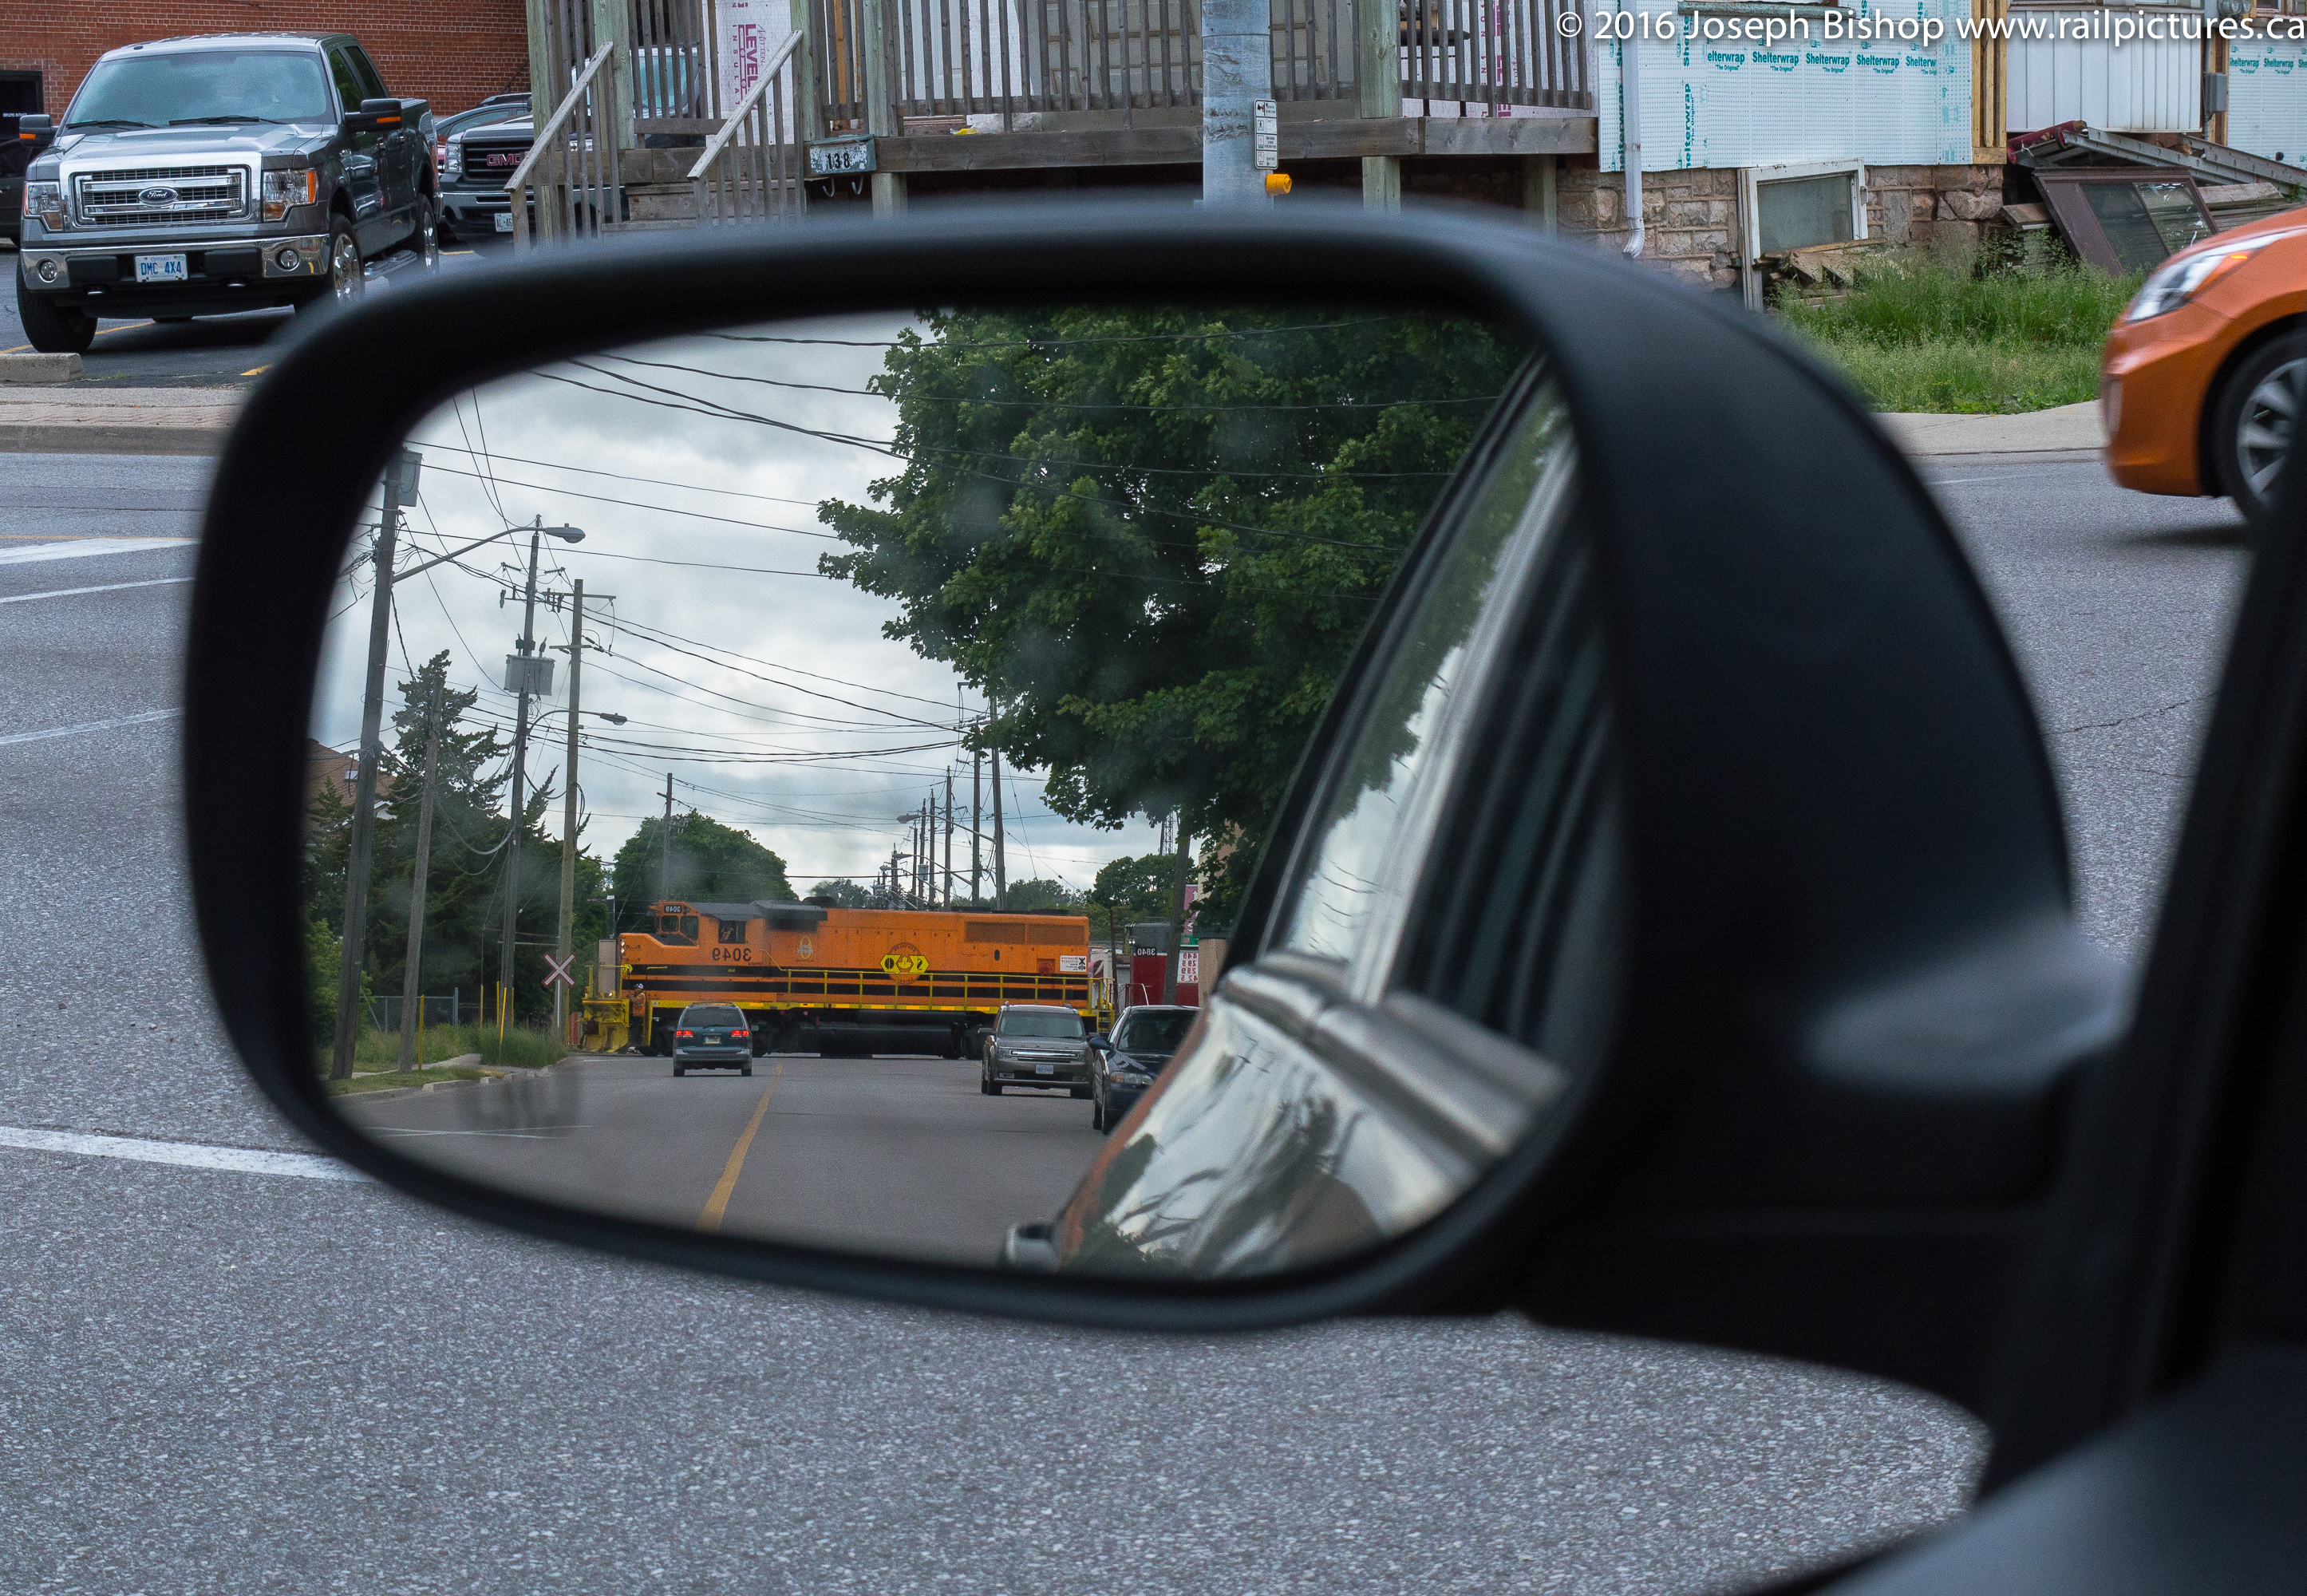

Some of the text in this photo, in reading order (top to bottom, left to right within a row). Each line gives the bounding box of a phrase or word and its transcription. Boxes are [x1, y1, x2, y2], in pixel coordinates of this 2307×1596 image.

[1752, 51, 1799, 66] Shelterwrap
[1806, 53, 1850, 67] Shelterwrap
[1857, 54, 1900, 68] Shelterwrap
[2264, 57, 2294, 70] Shelterwrap
[487, 153, 522, 166] GMC
[828, 152, 850, 169] 138
[147, 190, 167, 200] Ford
[140, 260, 182, 275] DMC 4X4
